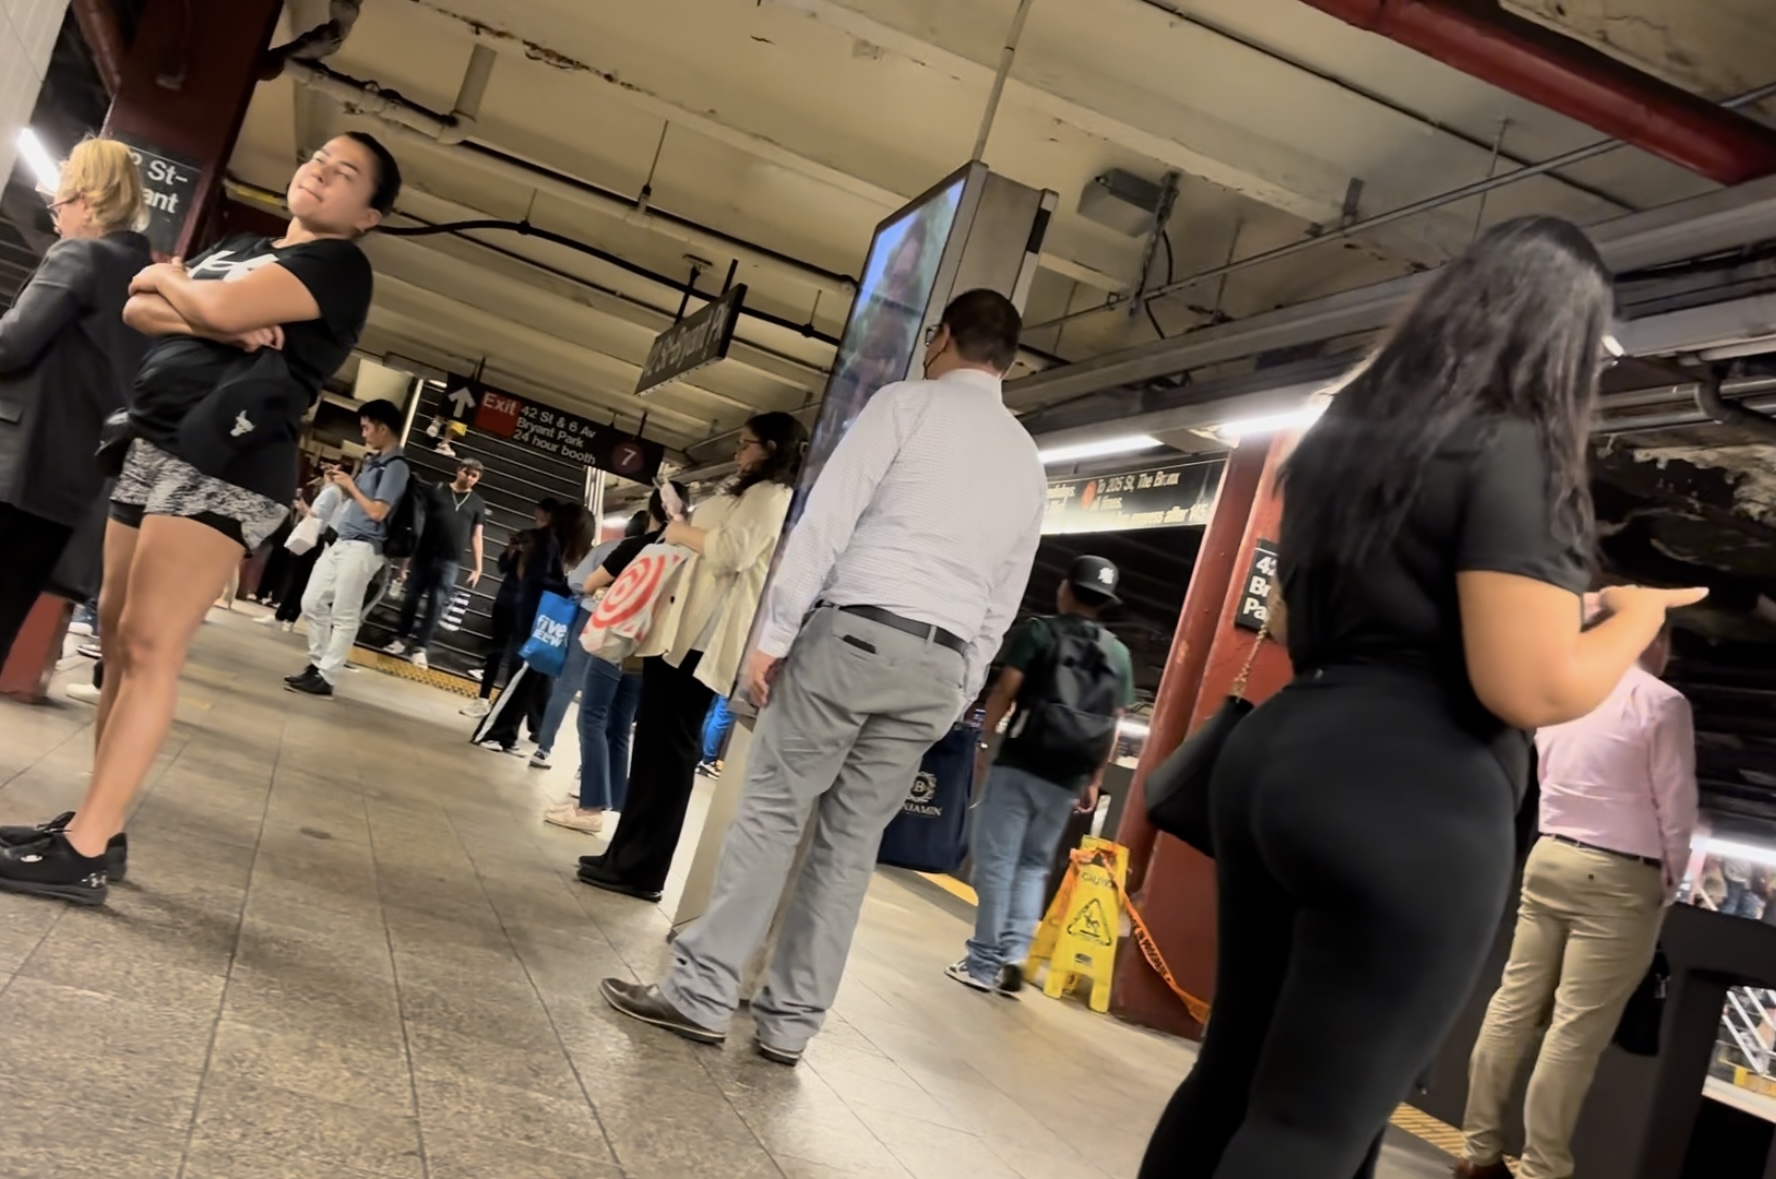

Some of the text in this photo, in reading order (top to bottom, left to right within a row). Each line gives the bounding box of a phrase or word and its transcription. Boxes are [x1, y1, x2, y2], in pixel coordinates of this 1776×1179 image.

[147, 160, 188, 185] St-
[482, 391, 517, 417] Exit
[516, 416, 584, 448] Bryant Park
[521, 406, 597, 439] 42 St & 6 Av
[513, 429, 596, 465] 24 hour booth
[620, 447, 637, 467] 7
[913, 780, 925, 792] B
